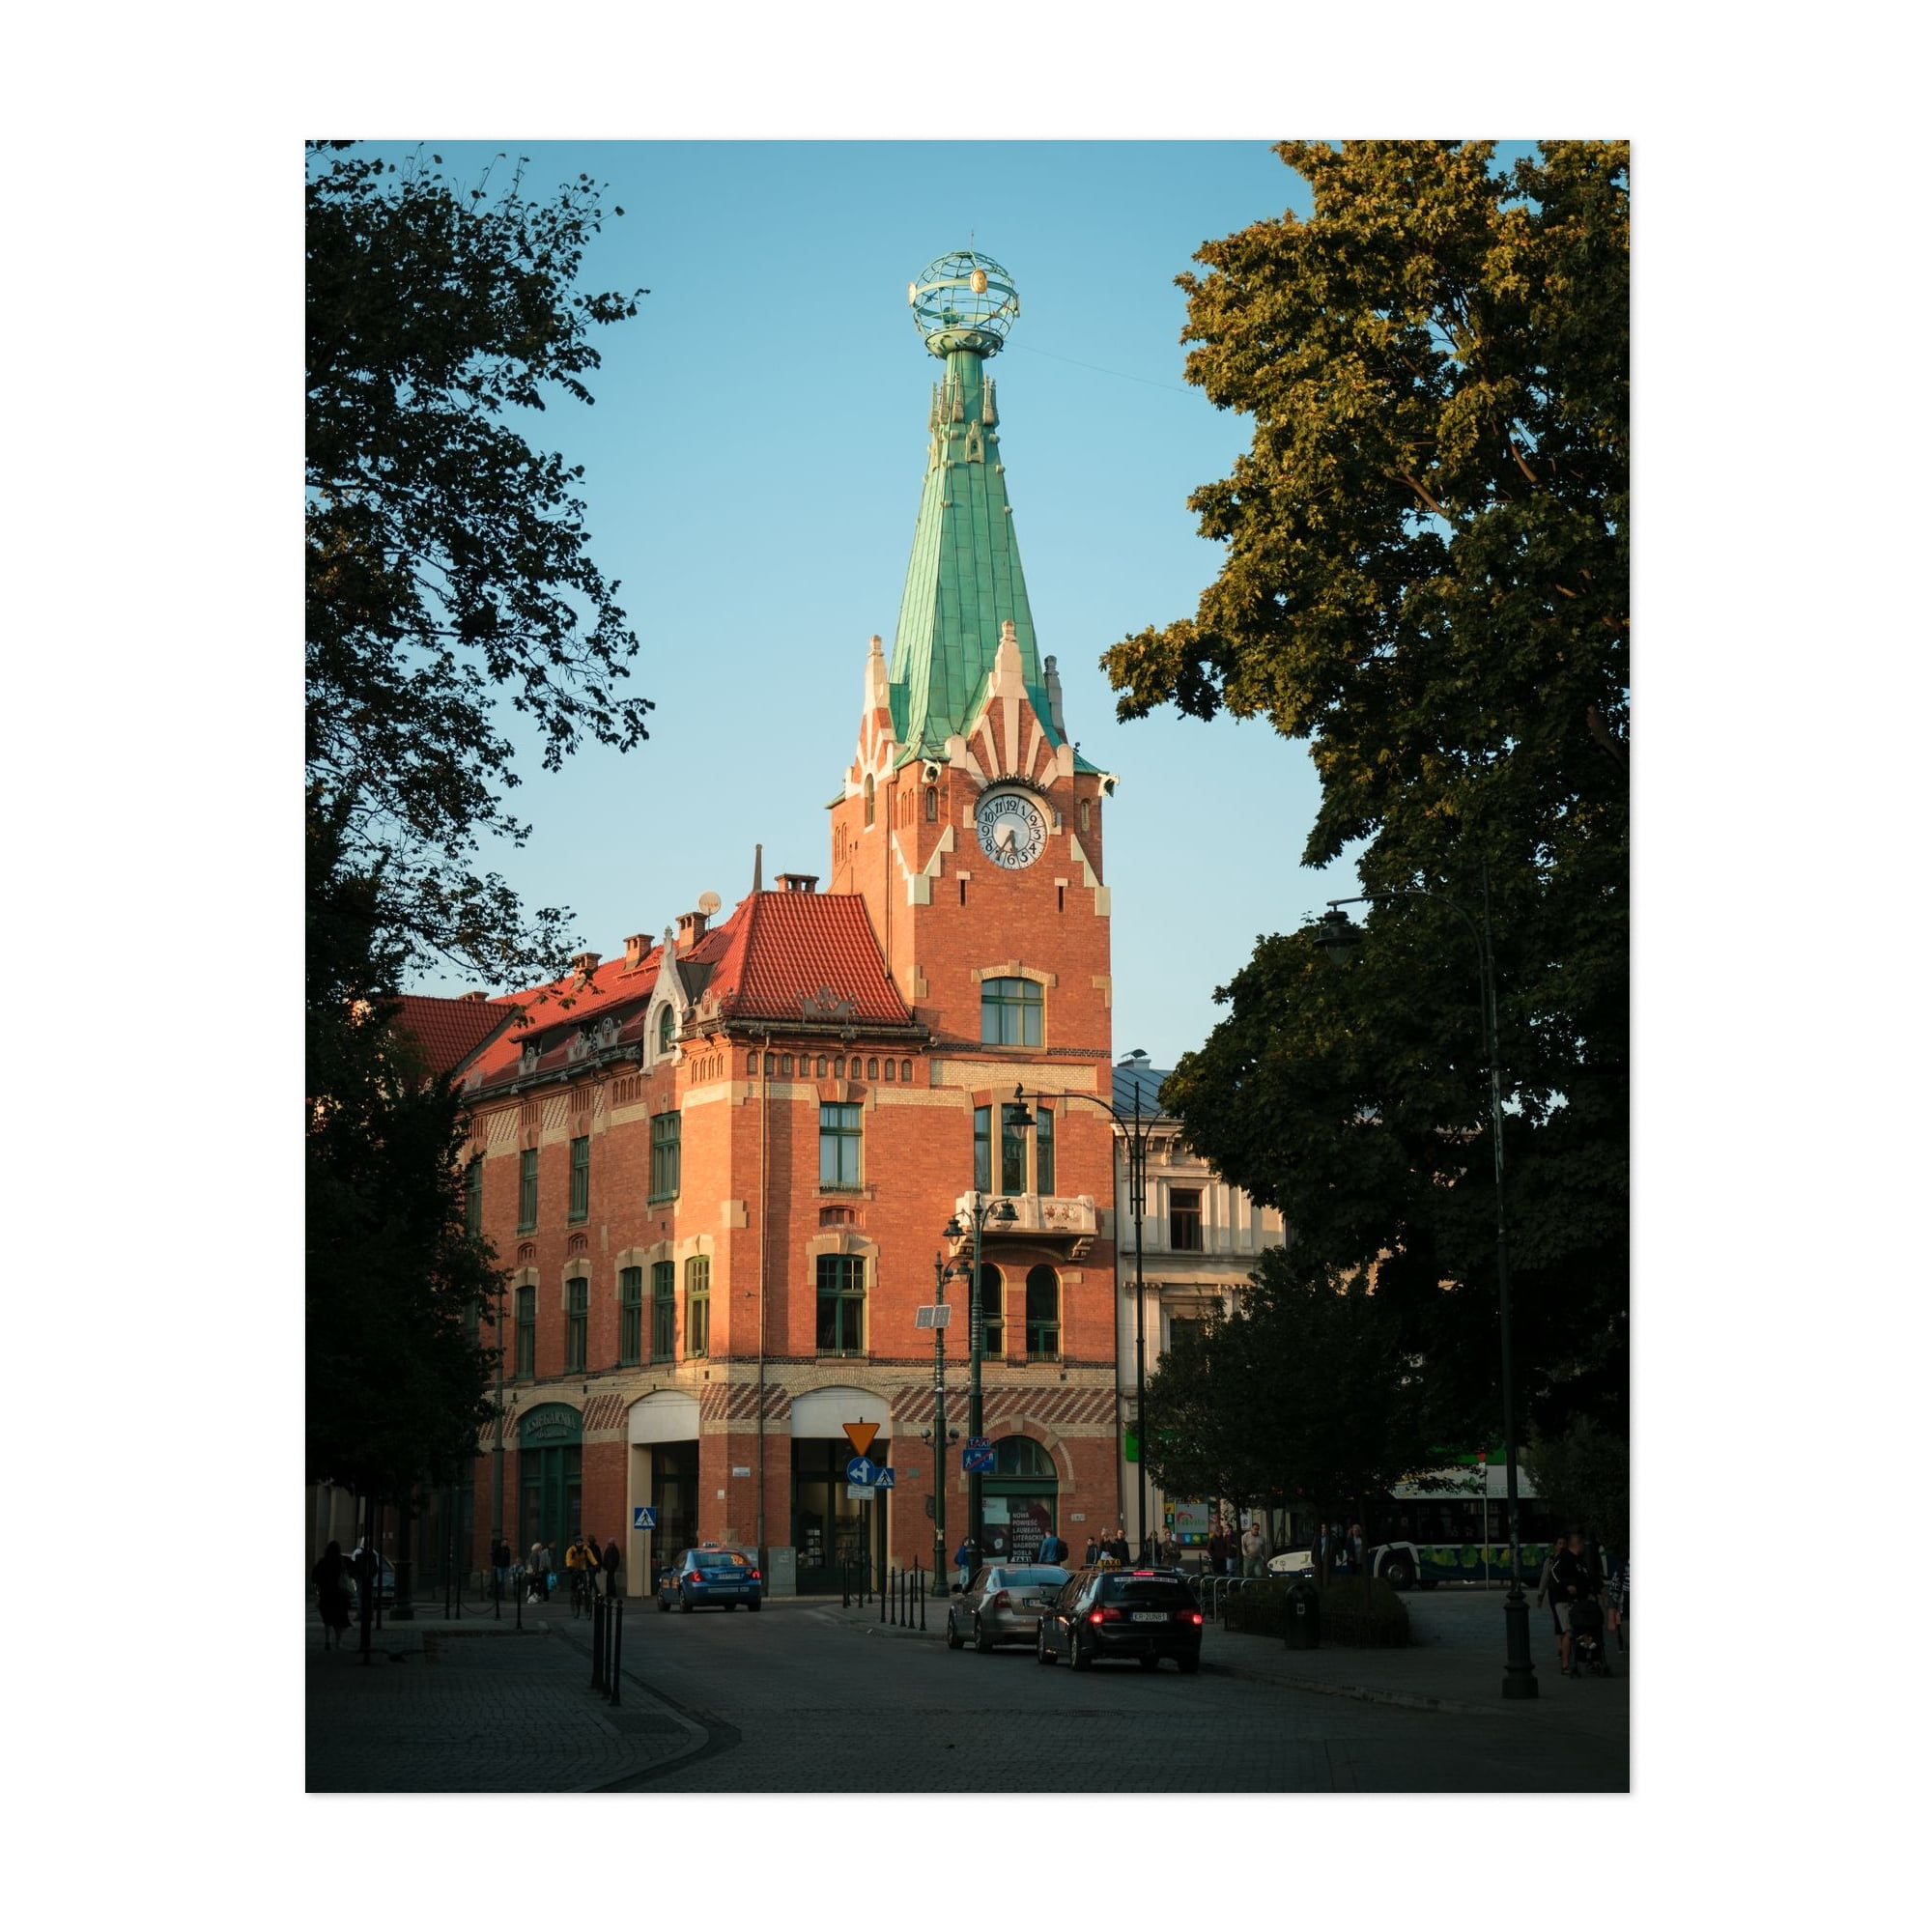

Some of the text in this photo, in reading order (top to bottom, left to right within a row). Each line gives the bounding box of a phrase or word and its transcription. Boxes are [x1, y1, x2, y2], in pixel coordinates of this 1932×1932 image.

[995, 802, 1003, 813] 11
[1006, 800, 1017, 811] 12
[1021, 805, 1026, 816] 1
[984, 811, 994, 823] 10
[1029, 815, 1037, 826] 2
[981, 825, 990, 837] 9
[1033, 829, 1041, 840] 3
[985, 838, 993, 851] 8
[1029, 842, 1037, 854] 4
[1007, 854, 1015, 866] 6
[1020, 851, 1028, 863] 5
